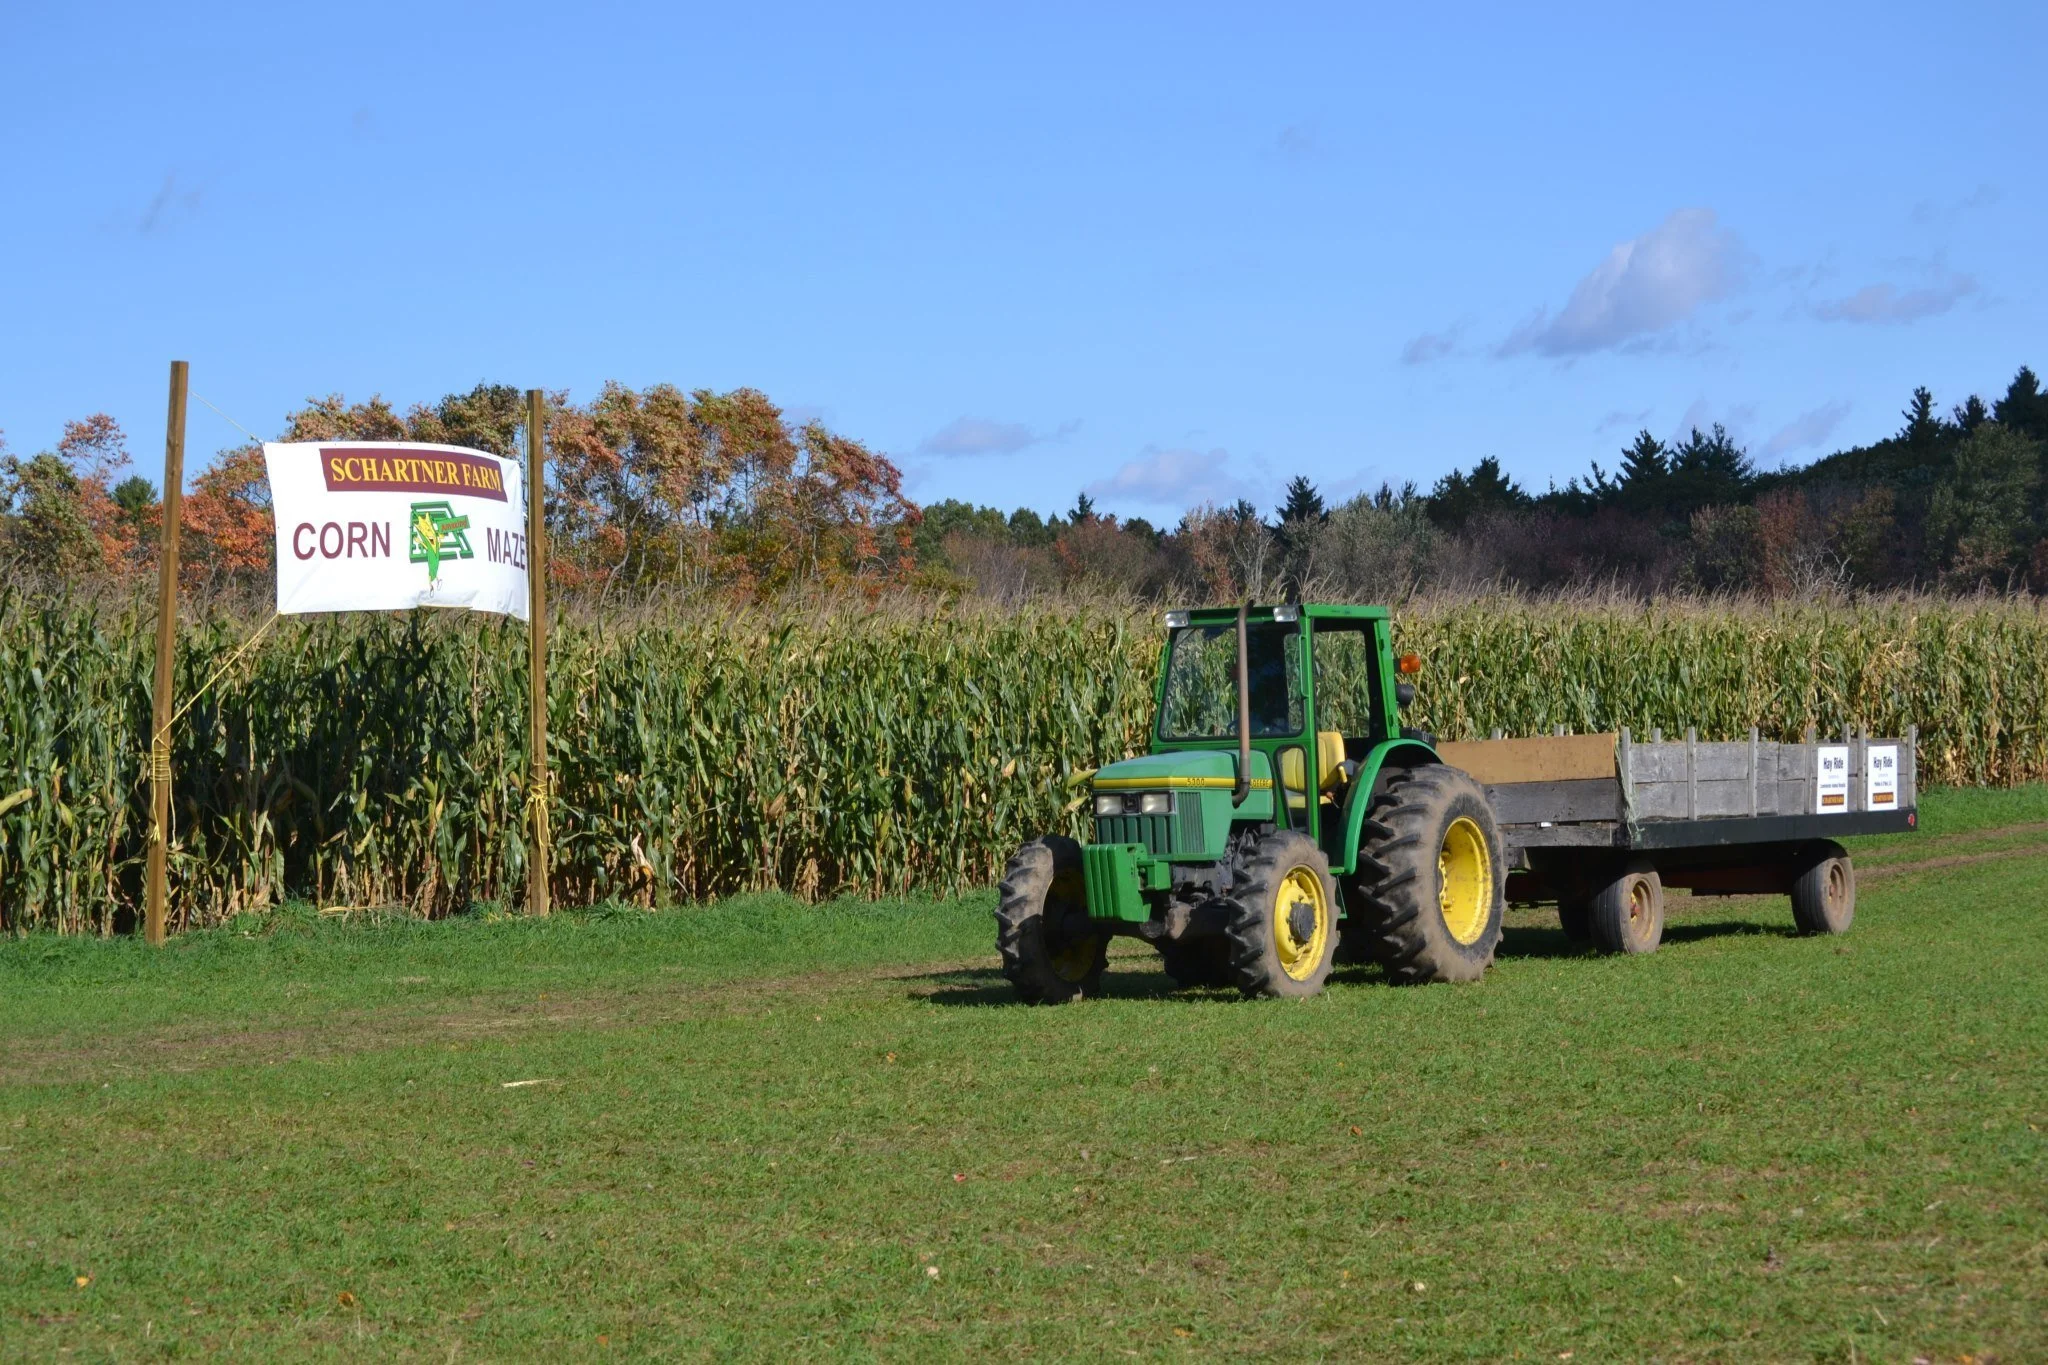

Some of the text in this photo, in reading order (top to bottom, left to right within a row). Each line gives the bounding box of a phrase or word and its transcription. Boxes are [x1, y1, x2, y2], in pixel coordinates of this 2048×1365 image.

[330, 457, 502, 492] SCHARTNER FARM
[293, 521, 526, 571] CORN MAZE
